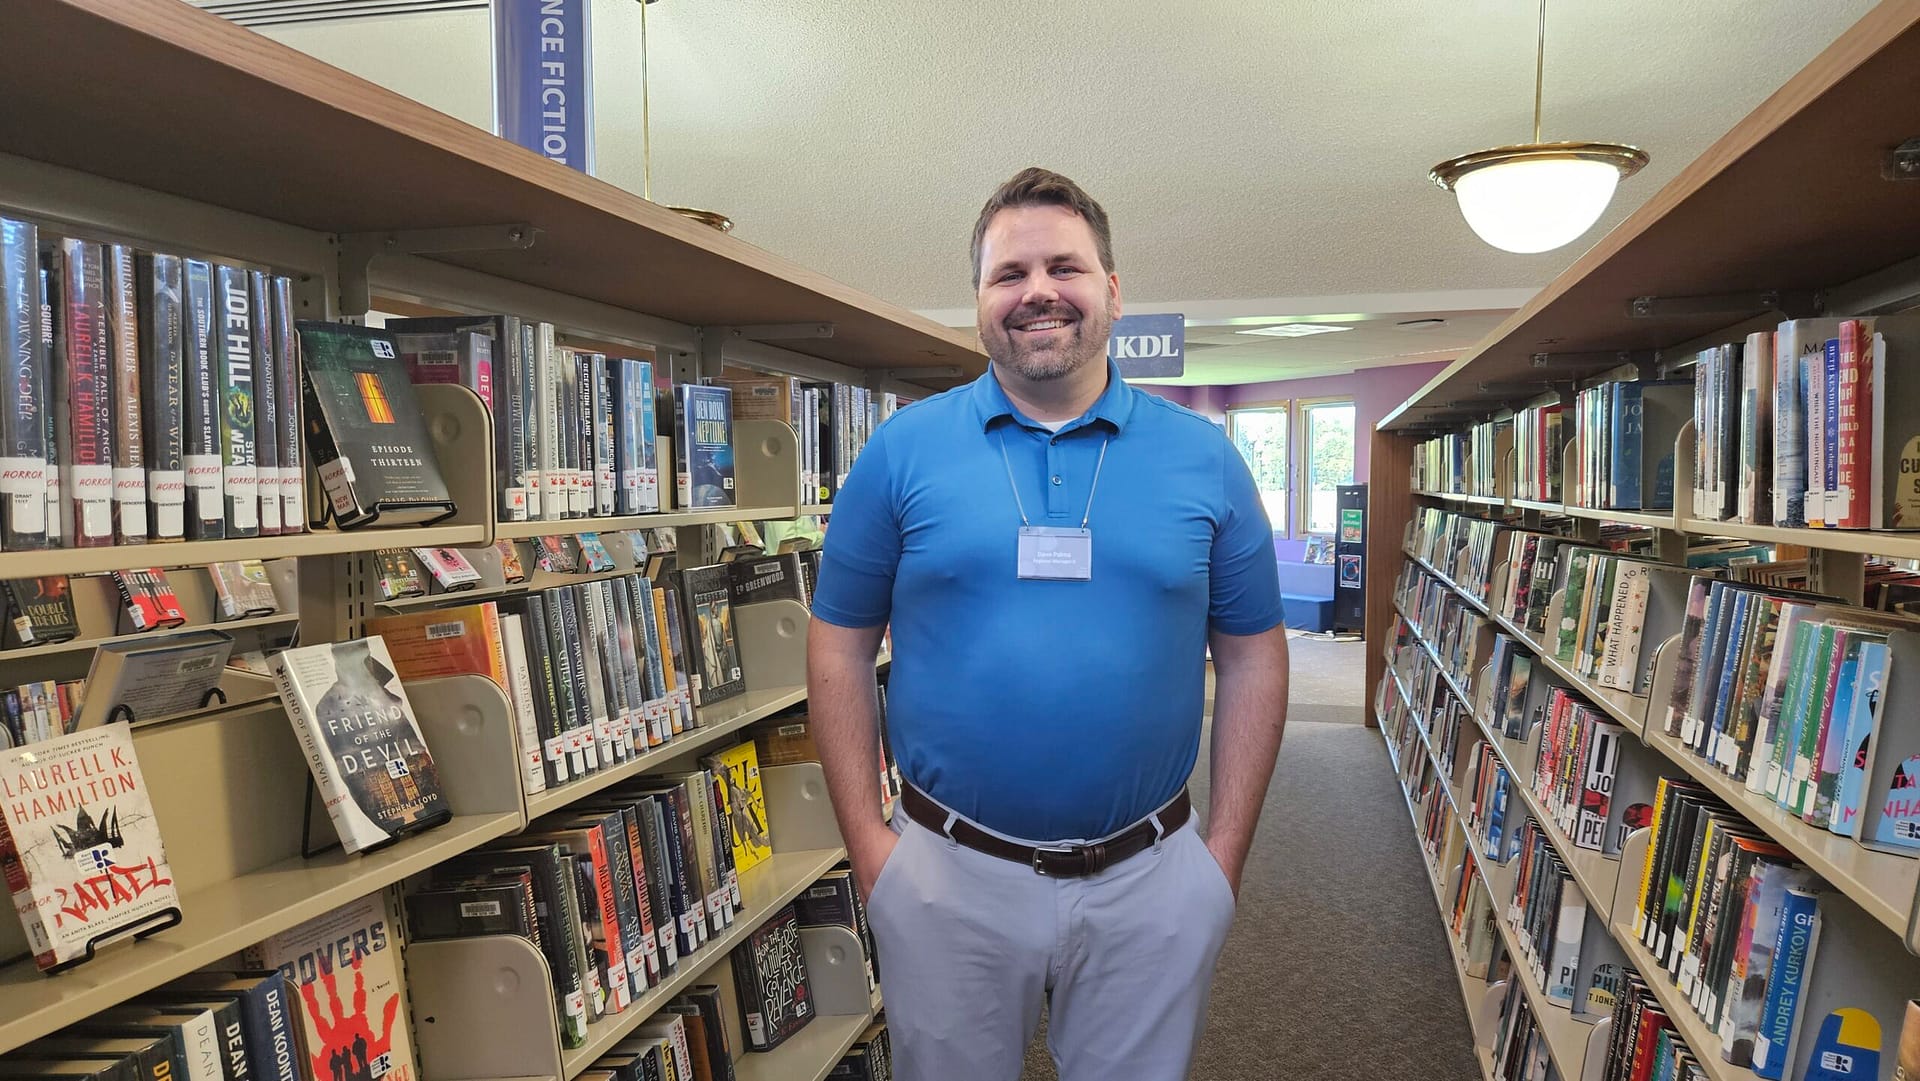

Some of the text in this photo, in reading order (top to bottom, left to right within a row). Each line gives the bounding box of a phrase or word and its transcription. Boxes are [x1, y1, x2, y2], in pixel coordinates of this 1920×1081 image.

[98, 314, 108, 370] TERRIBLE
[121, 253, 139, 440] HOUSE OF HUNGER ALEXIS
[198, 309, 207, 348] SOUTHERN
[226, 279, 251, 387] JOE HILL
[1115, 335, 1179, 358] KDL
[200, 352, 208, 369] BOOK
[264, 352, 273, 399] JONATHAN
[71, 302, 97, 465] LAURELL K. HAMILTO
[100, 375, 108, 403] FALL
[169, 363, 178, 406] YEAR
[101, 408, 109, 423] OF
[266, 401, 274, 422] JANZ
[696, 400, 725, 420] BEN BOVA
[102, 430, 111, 465] ANGE
[169, 427, 179, 470] WITC
[231, 430, 245, 466] WEA
[372, 445, 413, 454] EPISODE
[697, 421, 726, 443] NEPTUNE
[1849, 437, 1855, 447] A
[3, 471, 43, 479] HORROR
[371, 458, 423, 467] THIRTEEN
[630, 579, 640, 620] SHANNARA
[745, 571, 784, 592] GREENWOOD
[27, 602, 66, 617] DOUBLE
[551, 602, 561, 640] BROOKS
[565, 599, 575, 636] BROOKS
[602, 586, 612, 627] SHANNARA
[1612, 582, 1629, 633] HAPPENED
[1606, 635, 1621, 667] WHAT
[520, 665, 532, 717] BASILISK
[544, 655, 556, 707] INSISTENCE
[279, 675, 329, 787] FRIEND OF THE DEVIL
[327, 705, 402, 736] FRIEND
[354, 728, 392, 746] OF THE
[53, 734, 110, 752] TIMES BESTSELLING
[60, 748, 81, 758] SUCKER
[83, 742, 103, 751] PUNCH
[342, 738, 418, 774] DEVIL
[2, 746, 132, 798] LAURELL K.
[12, 771, 135, 824] HAMILTON
[378, 792, 438, 820] STEPHEN LLOYD
[54, 856, 171, 928] RAFAEL
[613, 841, 629, 903] CANAVAN
[131, 901, 153, 912] HUNTER
[155, 895, 171, 903] NOVEL
[526, 882, 539, 928] IMMUNITY
[599, 864, 618, 925] MEG CABOT
[635, 869, 651, 926] SCORPION
[1692, 833, 1719, 955] THIS TENDER LAND
[556, 869, 576, 968] INTERFERENCE
[768, 927, 781, 946] THE
[1778, 906, 1788, 932] GREY
[278, 921, 387, 990] ROVERS
[758, 918, 798, 994] MULTIVERSE
[1773, 933, 1783, 961] BEES
[765, 955, 806, 1034] REVENGE
[766, 951, 792, 998] GOT ITS
[1772, 982, 1796, 1046] ANDREY
[1785, 923, 1809, 988] KURKOV
[265, 989, 294, 1081] DEAN KOONT
[1626, 1002, 1642, 1056] DARK MUSIC
[1759, 998, 1770, 1034] KURKO
[197, 1024, 216, 1077] DEAN
[226, 1021, 248, 1079] DEAN
